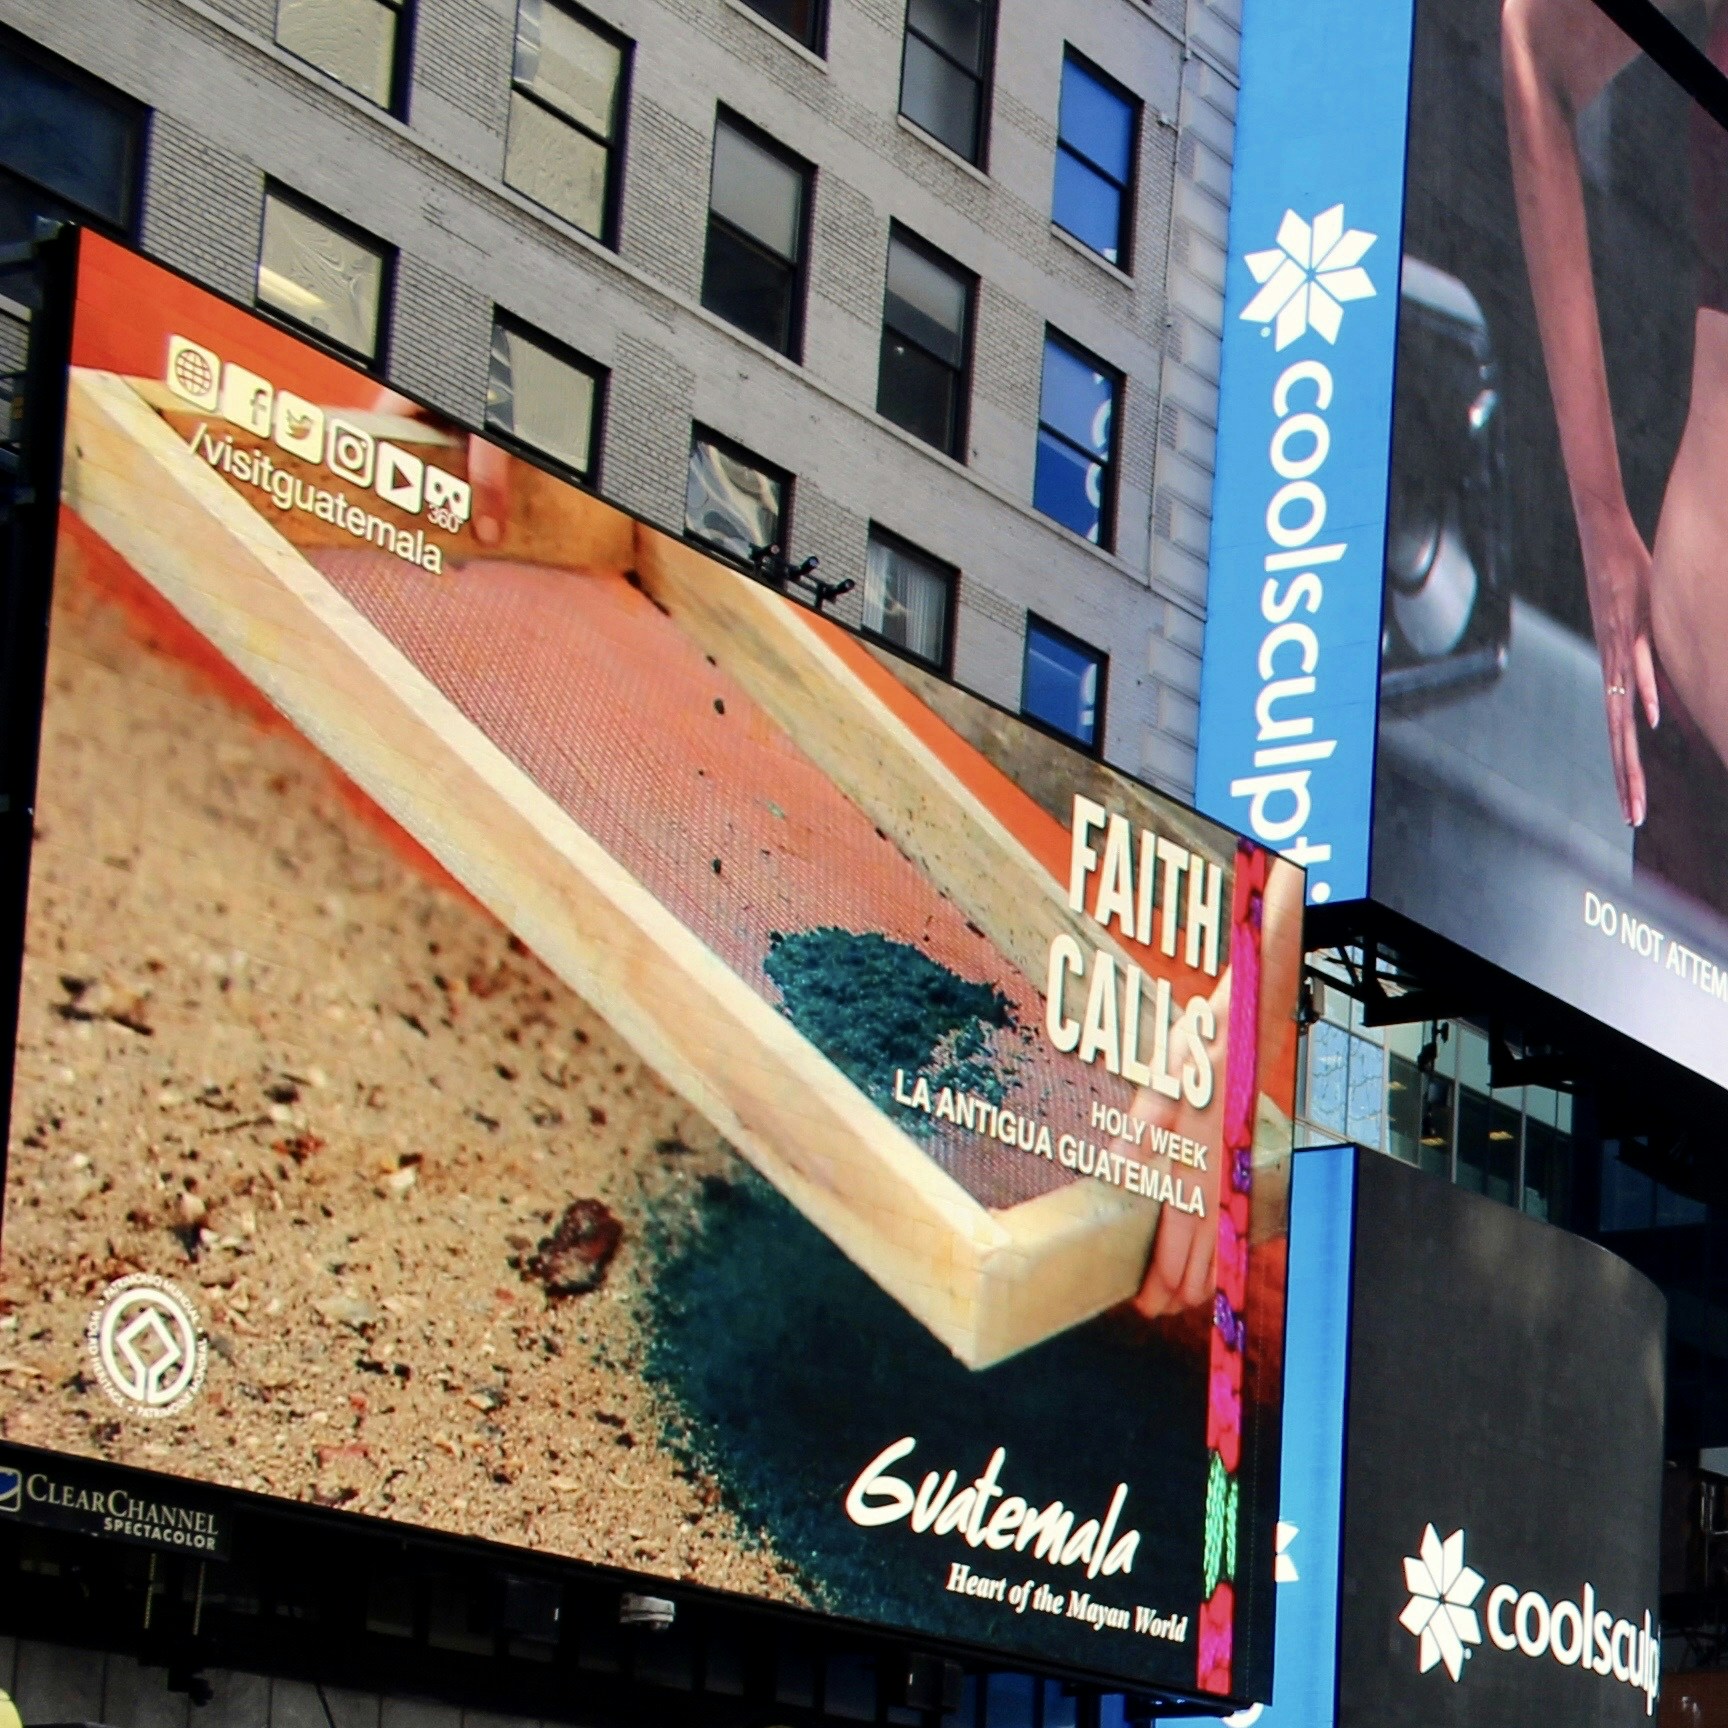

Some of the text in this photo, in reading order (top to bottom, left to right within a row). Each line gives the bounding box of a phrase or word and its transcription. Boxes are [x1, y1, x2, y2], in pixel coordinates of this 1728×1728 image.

[189, 424, 443, 575] /visitguatemala
[1068, 794, 1223, 977] FAITH
[1582, 890, 1620, 933] DO
[1621, 908, 1666, 962] NOT
[1045, 933, 1216, 1111] CALLS
[894, 1068, 1206, 1219] LA ANTIGUA GUATEMALA
[1091, 1101, 1208, 1172] HOLY WEEK
[103, 1517, 216, 1551] SPECTACOLOR
[846, 1436, 1140, 1580] Guatemala
[945, 1561, 1189, 1643] Heart of the Mayan World
[1487, 1582, 1660, 1716] coolsculp
